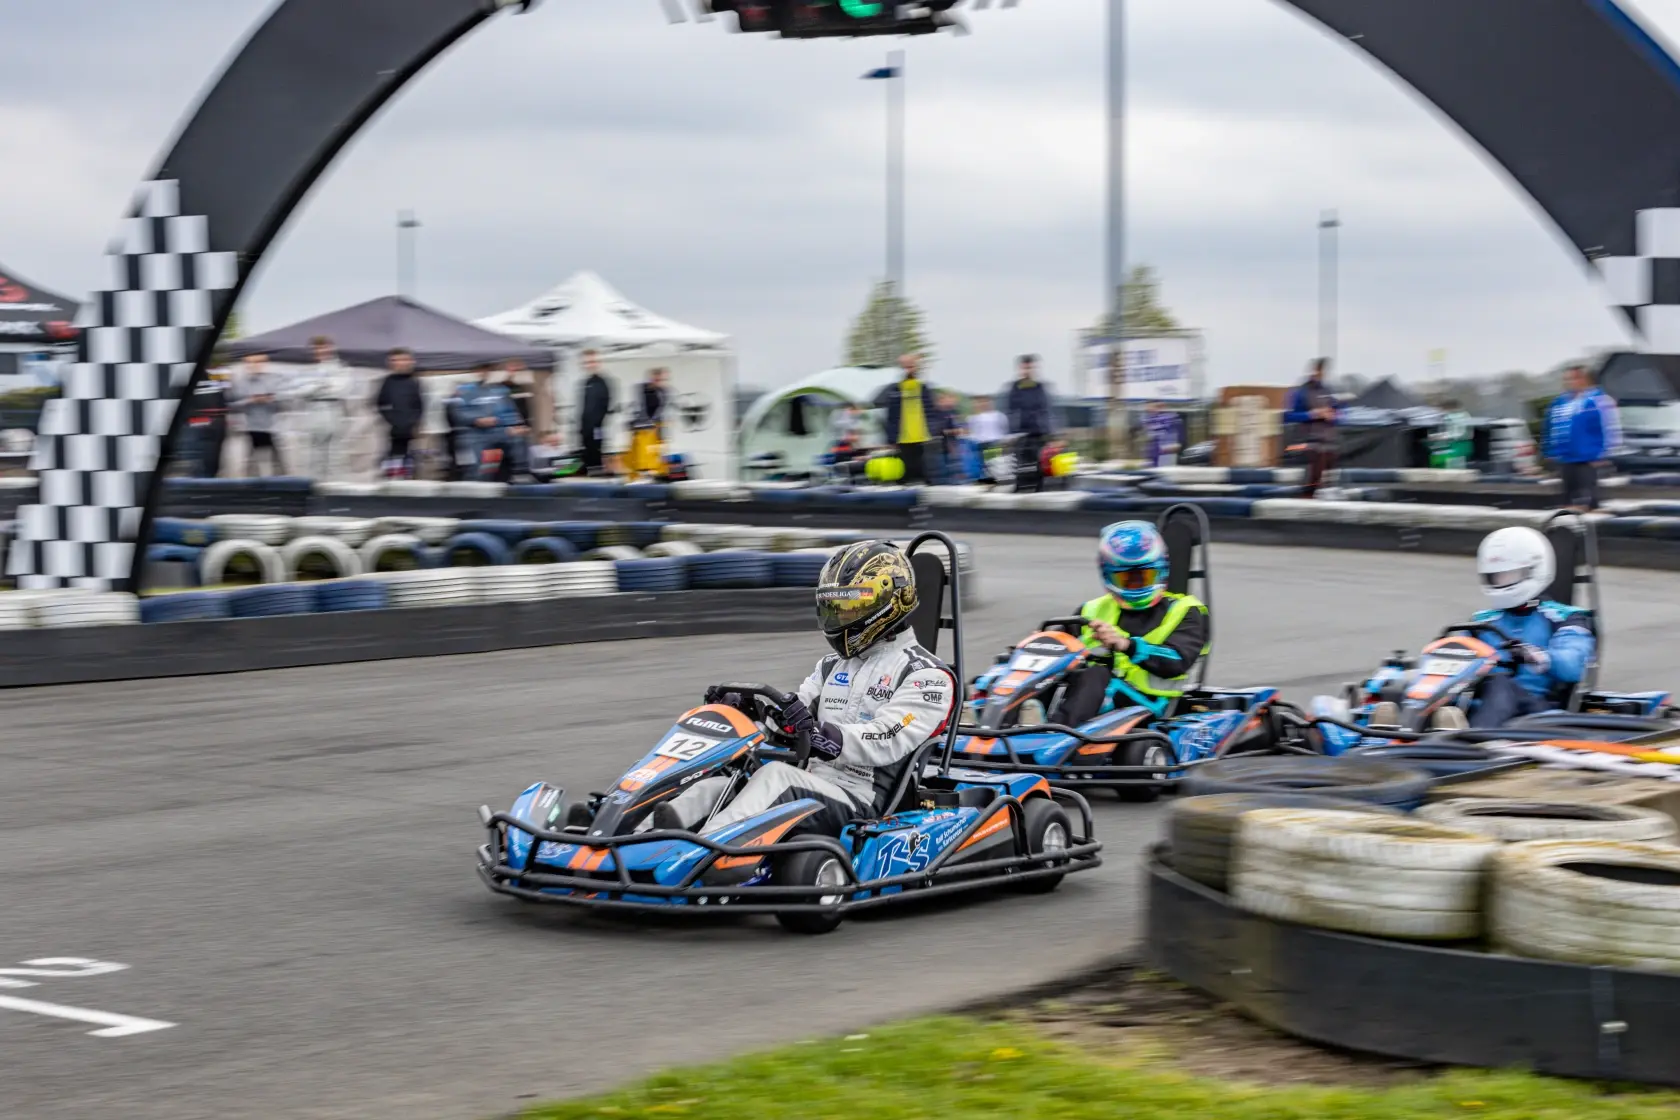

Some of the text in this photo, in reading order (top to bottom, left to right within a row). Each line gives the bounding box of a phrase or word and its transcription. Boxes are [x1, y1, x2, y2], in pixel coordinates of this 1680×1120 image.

[866, 687, 894, 700] BILAND
[923, 693, 943, 703] OMP
[667, 738, 707, 757] 12
